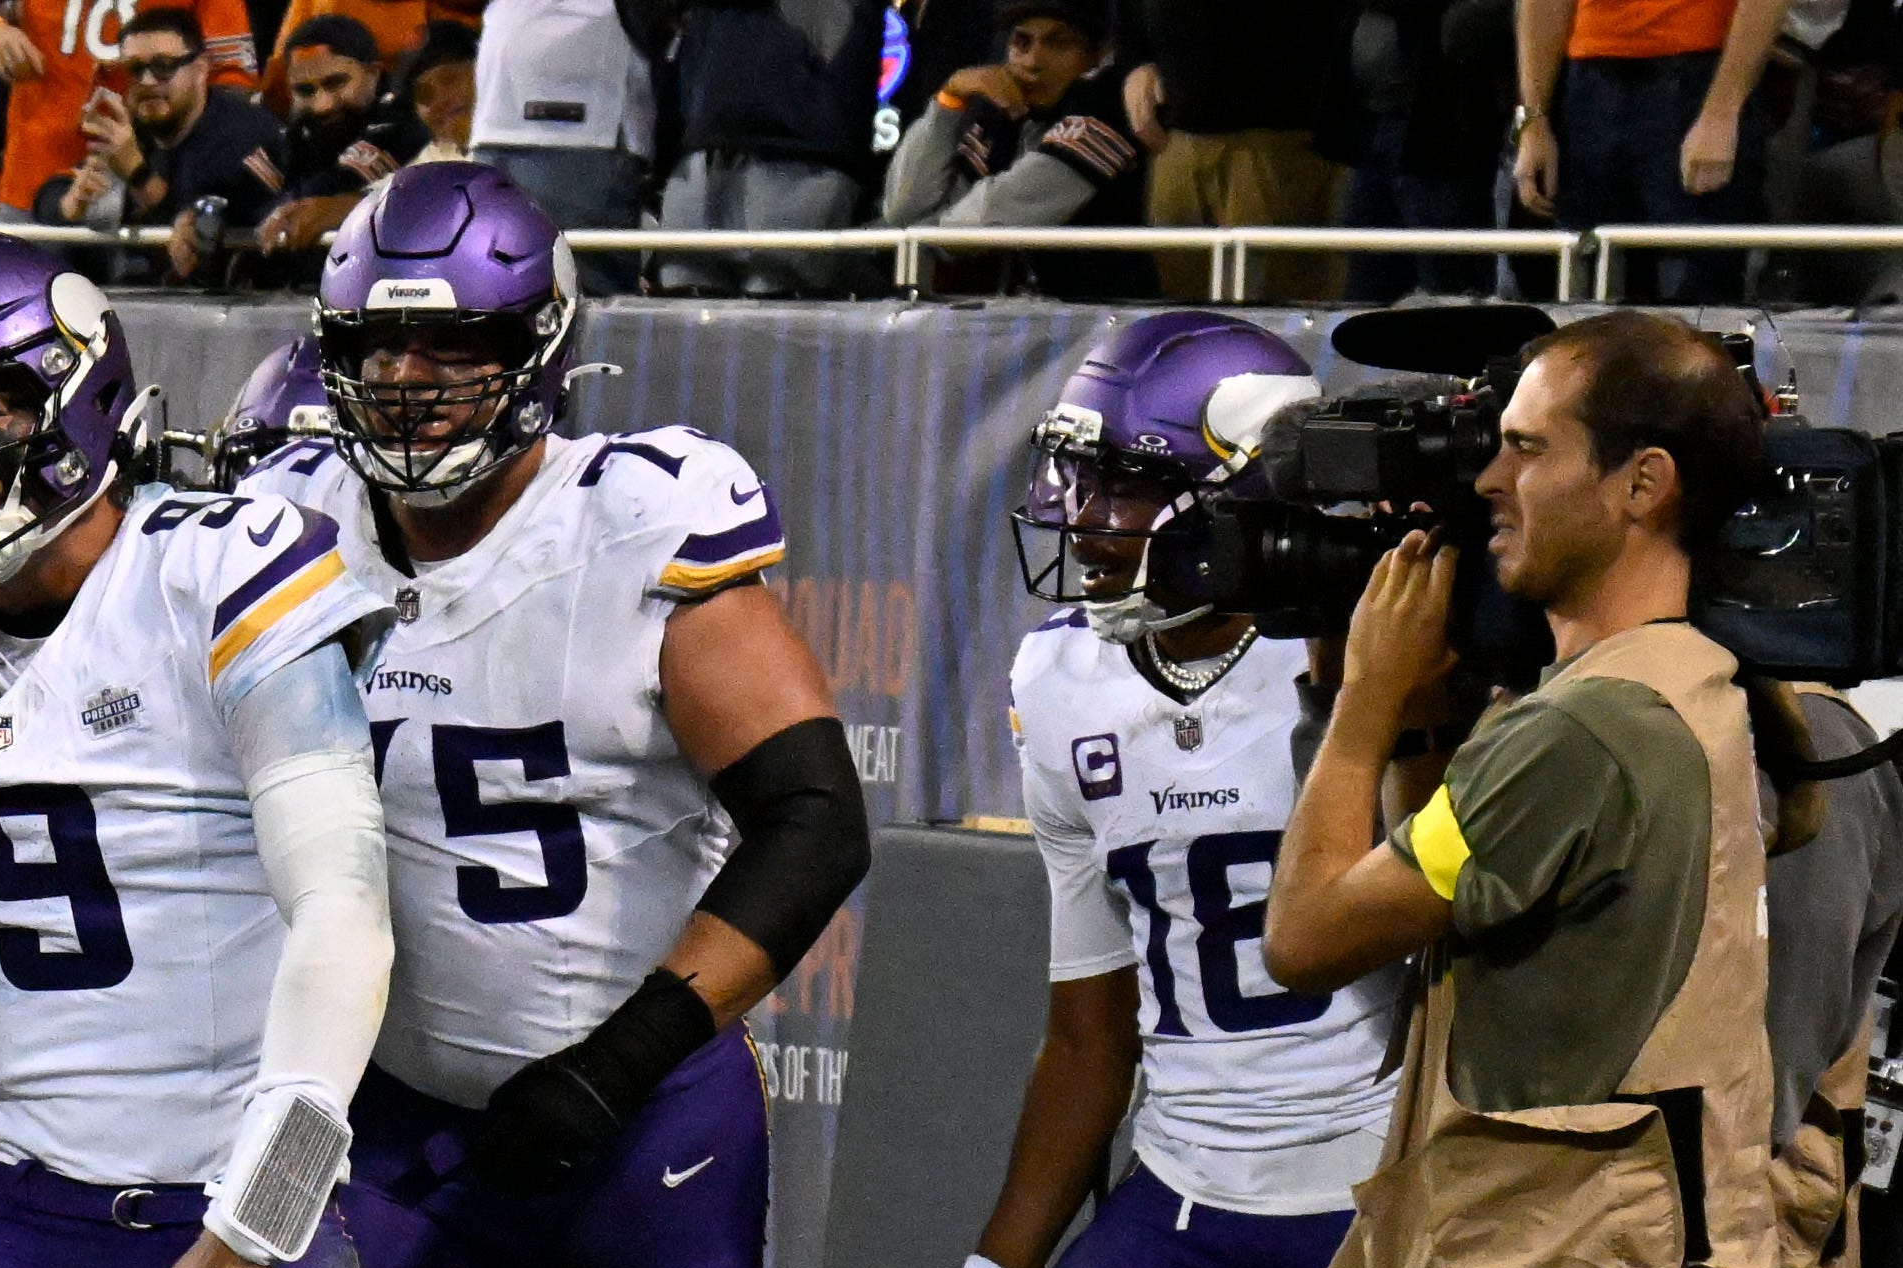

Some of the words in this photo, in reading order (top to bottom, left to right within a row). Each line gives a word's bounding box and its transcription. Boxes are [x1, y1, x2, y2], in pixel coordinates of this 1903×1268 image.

[1076, 738, 1116, 784] C
[1107, 829, 1334, 1037] 18
[783, 1045, 811, 1102] OF
[816, 1047, 849, 1106] TH
